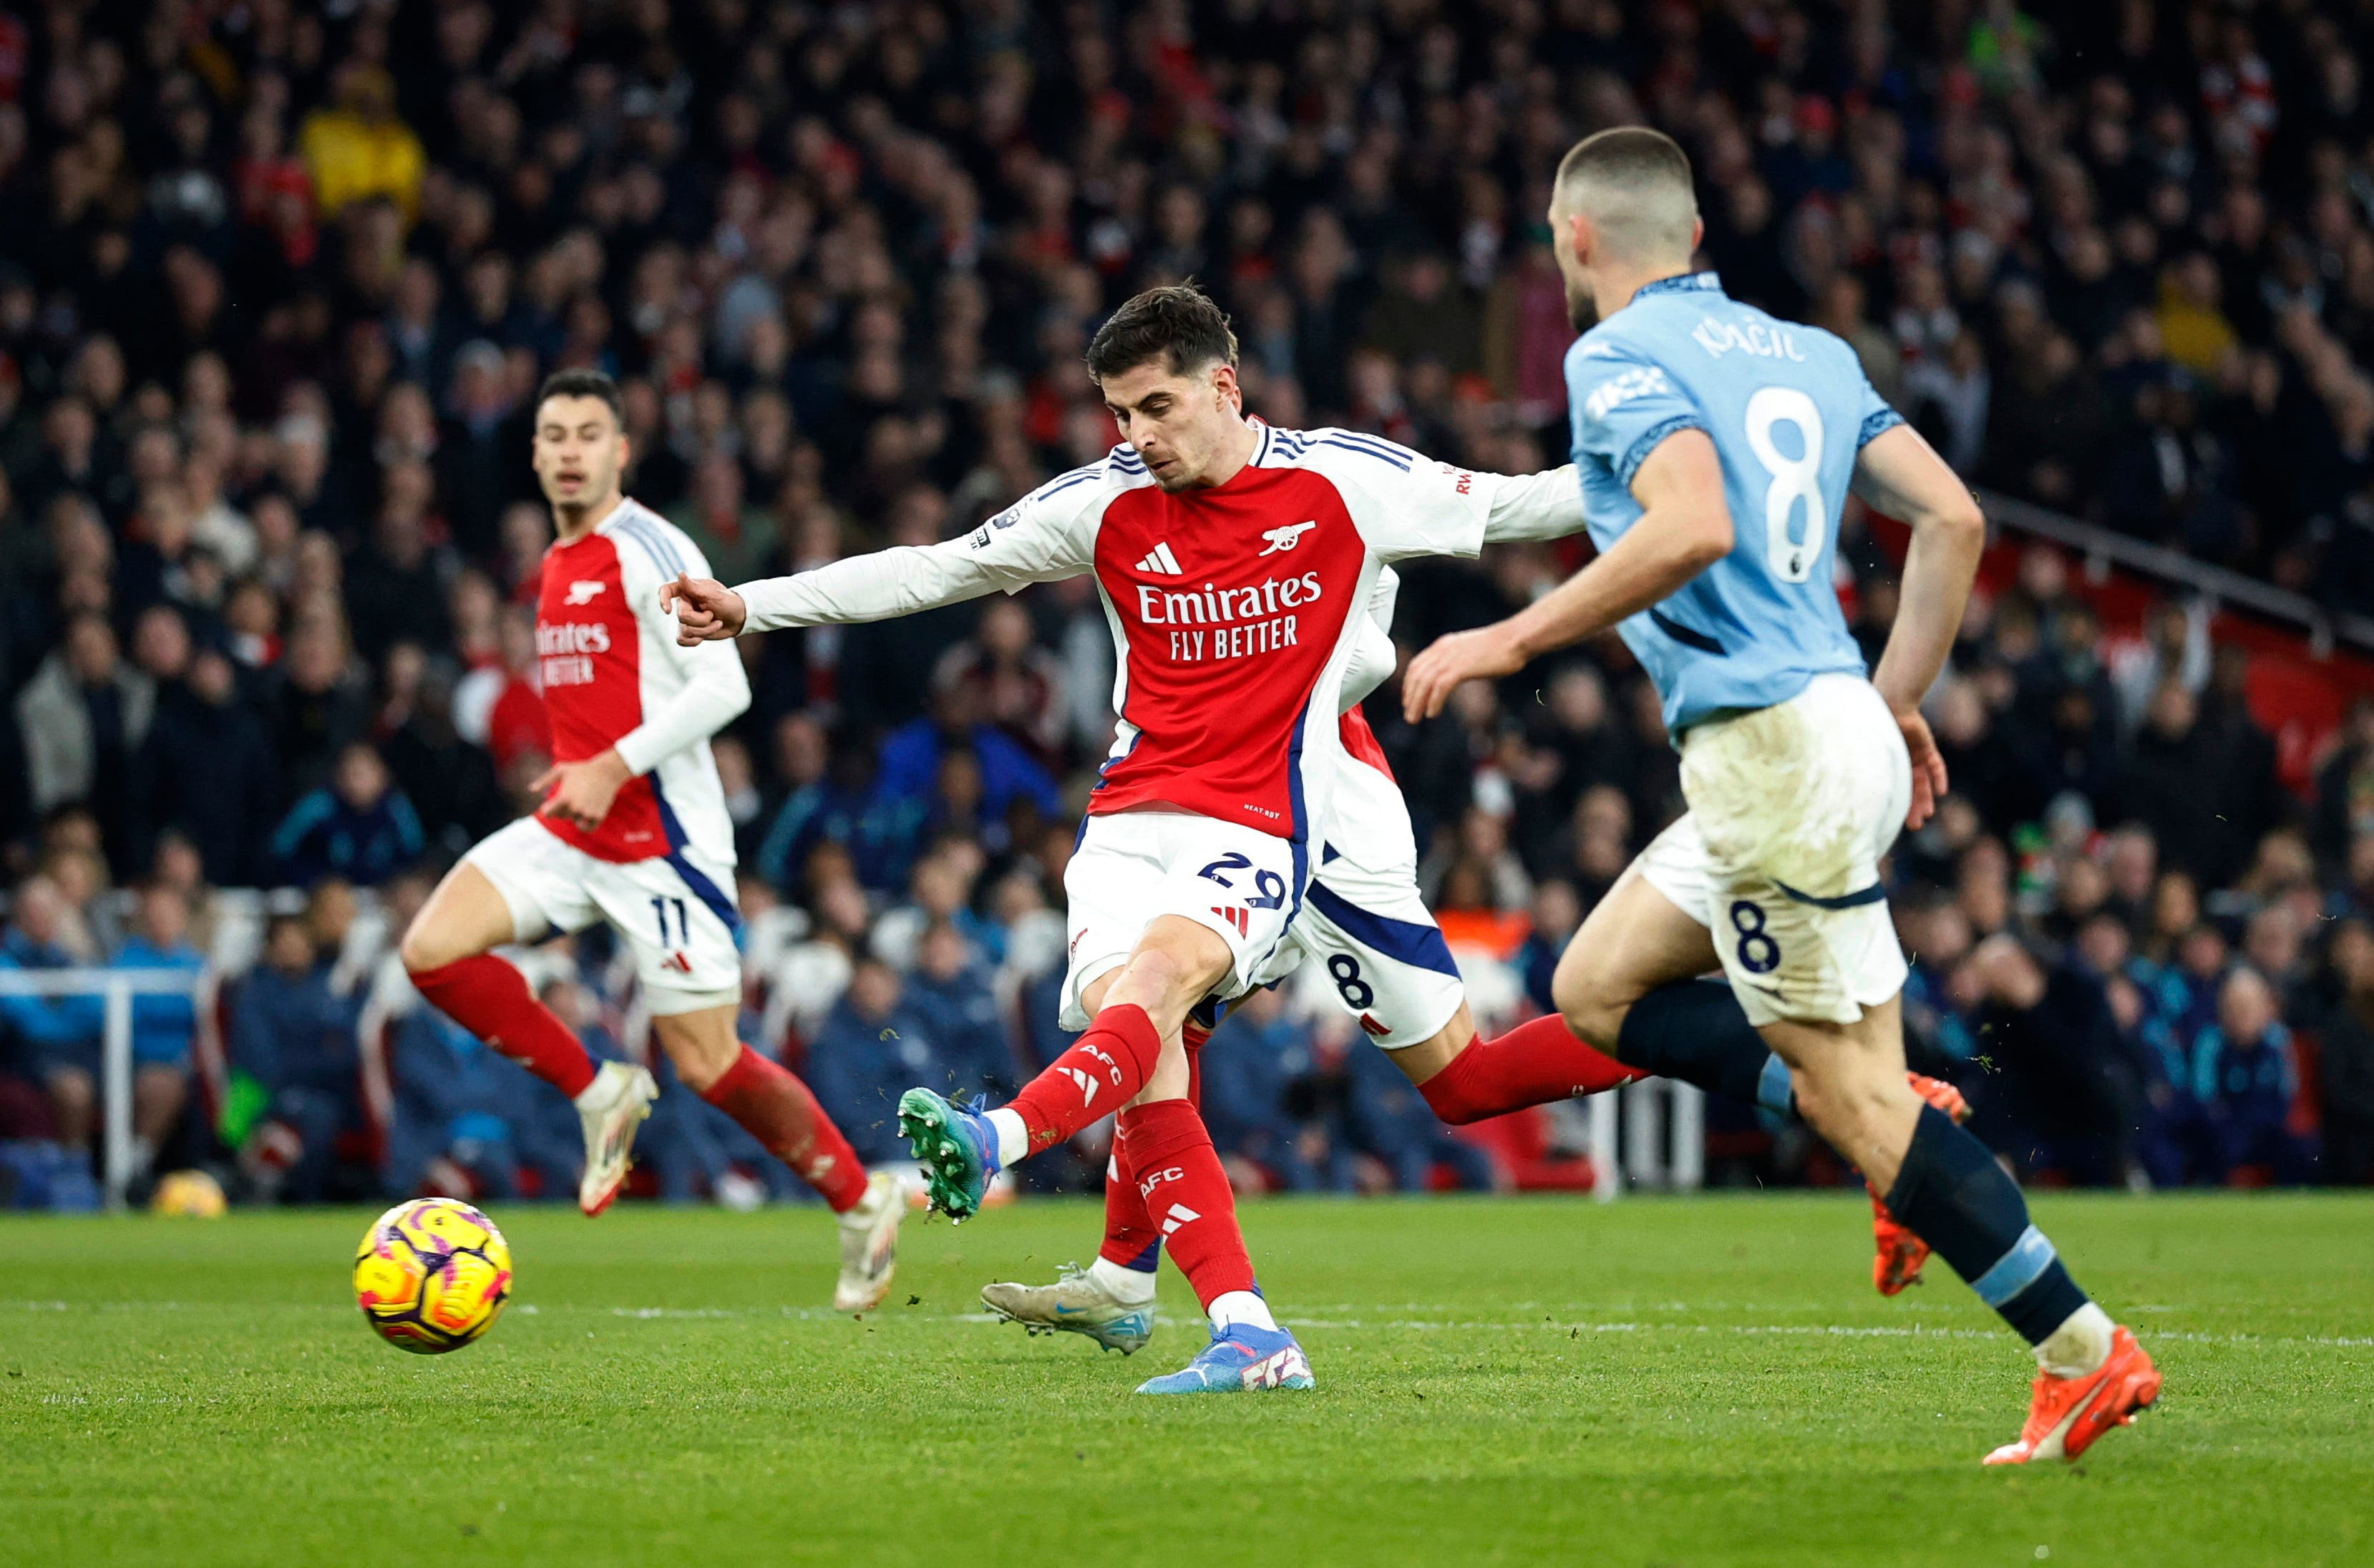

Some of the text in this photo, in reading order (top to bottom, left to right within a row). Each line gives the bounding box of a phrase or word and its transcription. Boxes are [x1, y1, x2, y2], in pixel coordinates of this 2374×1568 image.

[1745, 384, 1826, 584] 8
[1135, 571, 1322, 625] Emirates
[1170, 615, 1298, 661] FLY BETTER
[1244, 804, 1280, 819] HEAT.RDY
[1197, 852, 1286, 910] 29
[651, 895, 689, 948] 11
[1729, 900, 1781, 975] 8
[1328, 954, 1373, 1010] 8
[1079, 1044, 1122, 1086] AFC
[1140, 1167, 1184, 1199] AFC
